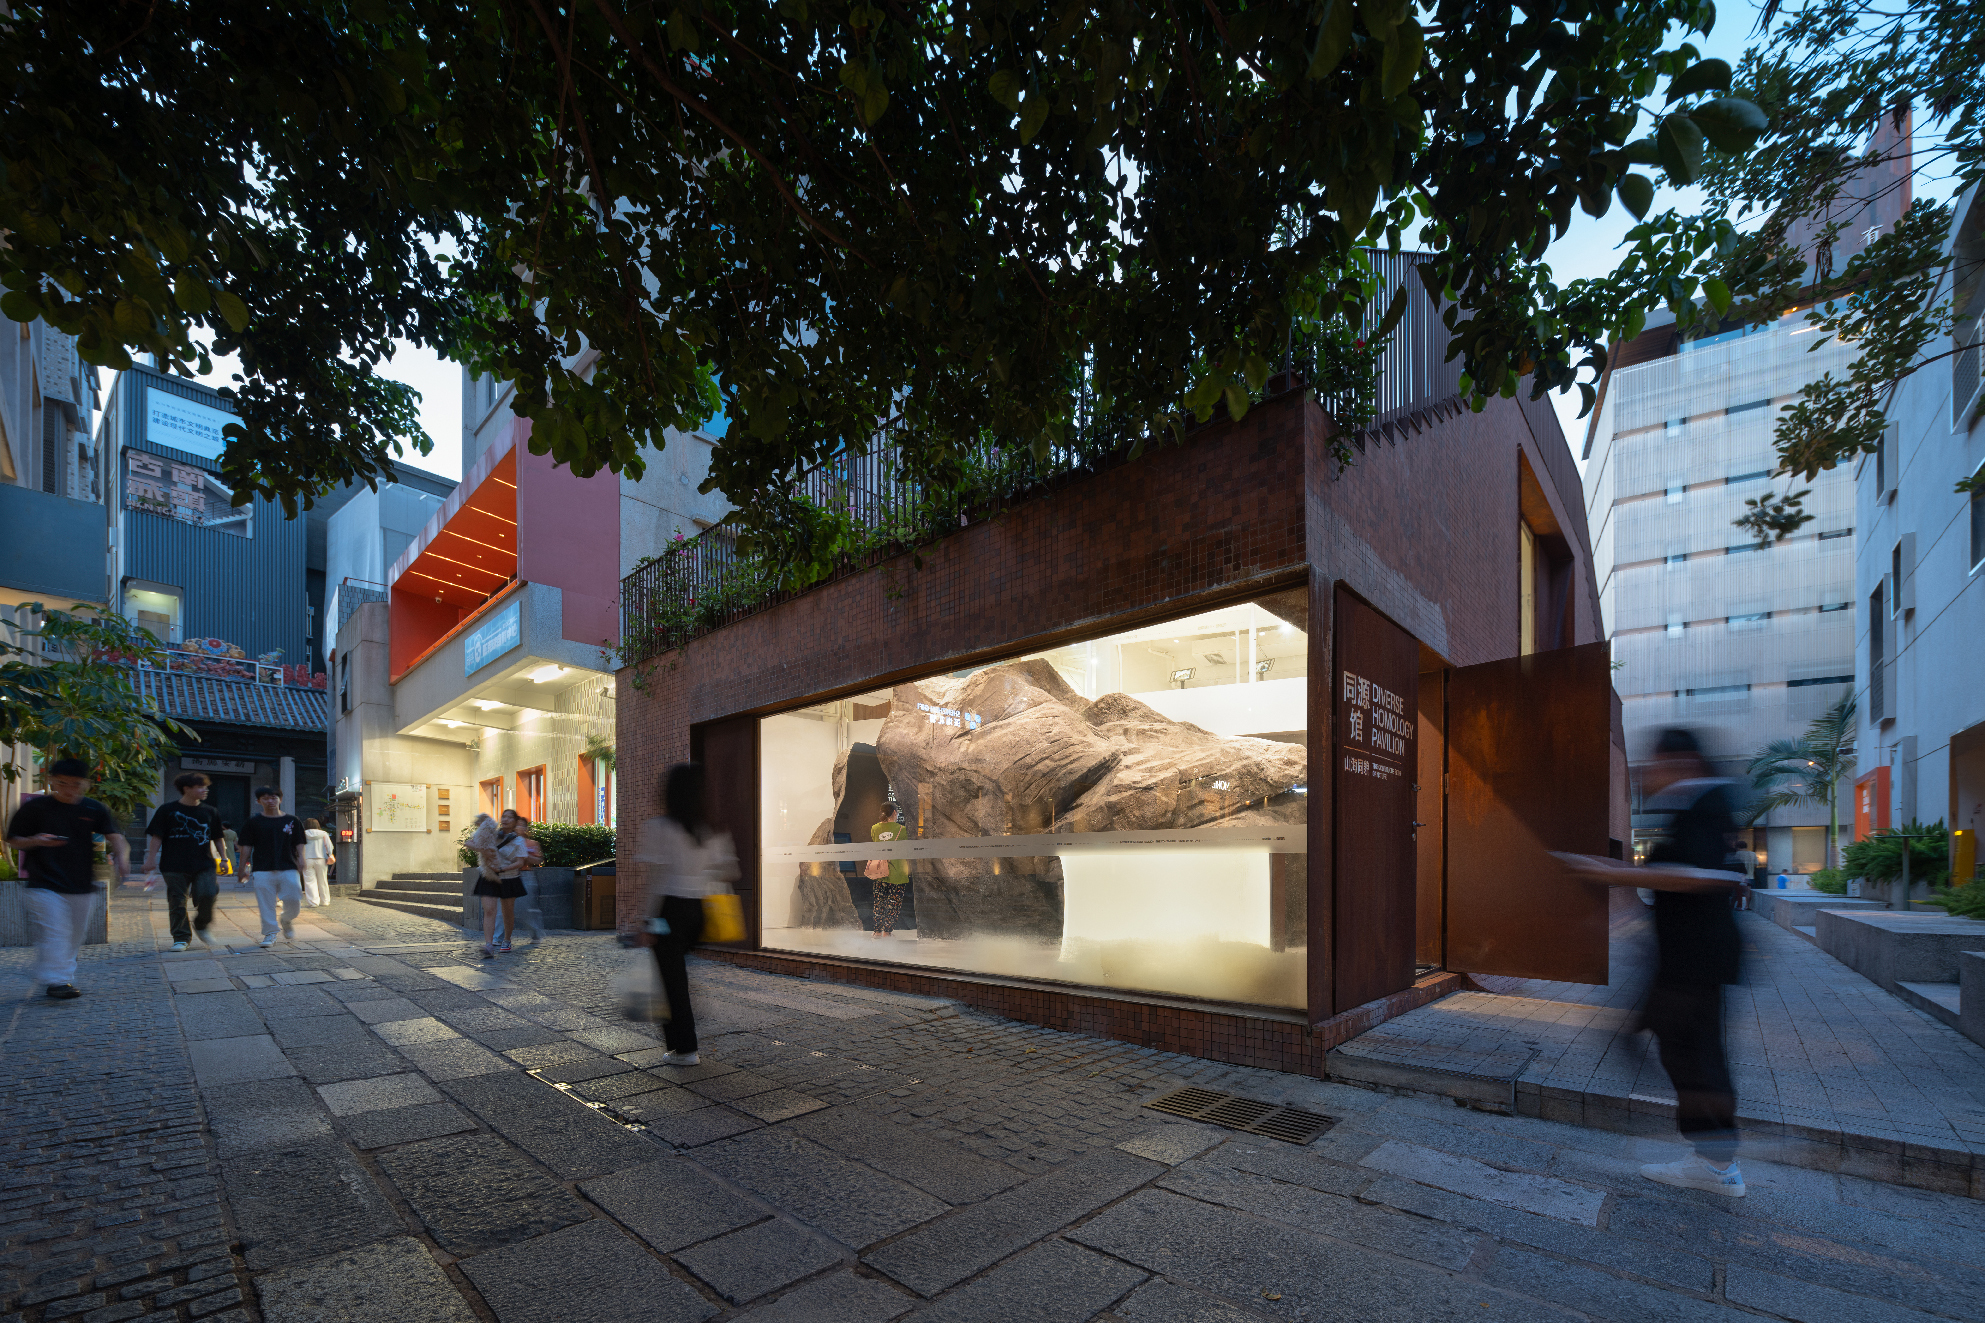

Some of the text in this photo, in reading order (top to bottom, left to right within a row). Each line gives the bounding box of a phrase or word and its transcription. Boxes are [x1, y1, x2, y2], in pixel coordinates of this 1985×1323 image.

[1343, 671, 1370, 709] 同源
[1372, 683, 1403, 715] DIVERSE
[1372, 706, 1413, 739] HOMOLOGY
[1371, 728, 1404, 756] PAVILION
